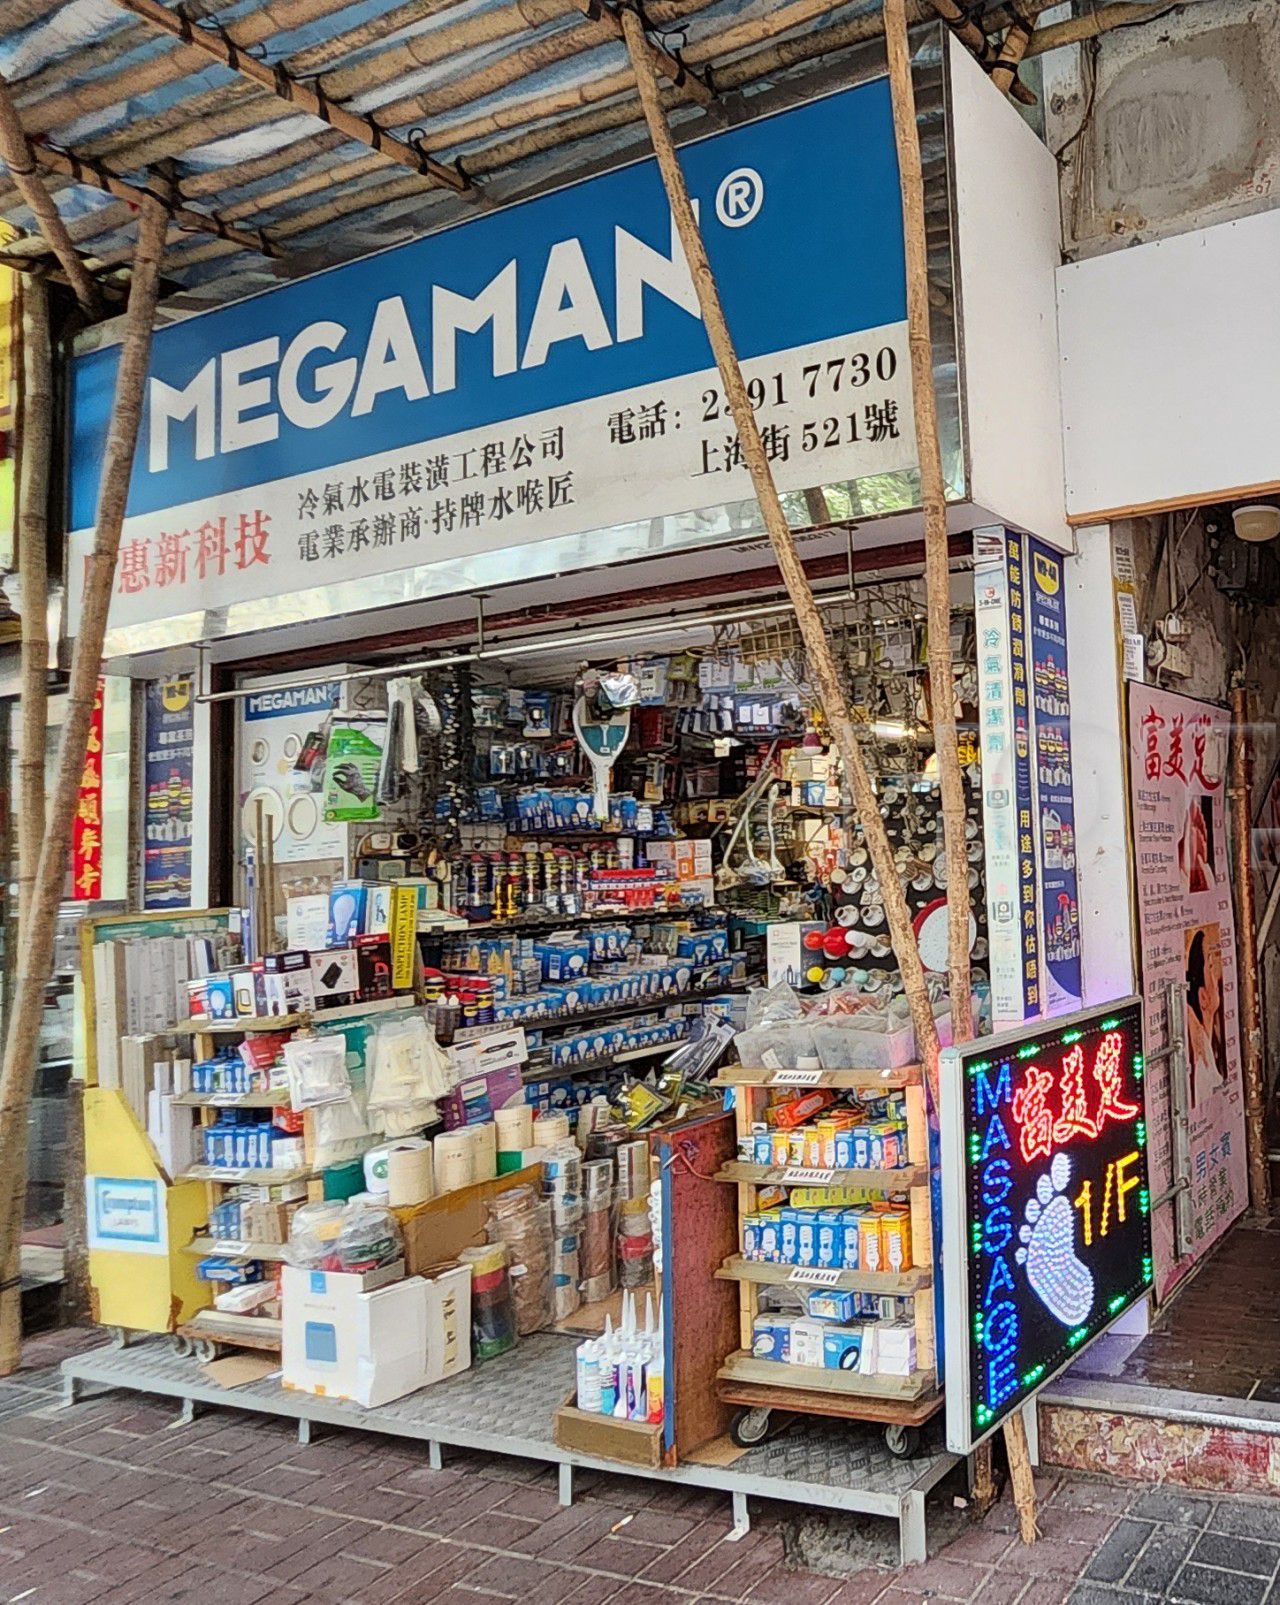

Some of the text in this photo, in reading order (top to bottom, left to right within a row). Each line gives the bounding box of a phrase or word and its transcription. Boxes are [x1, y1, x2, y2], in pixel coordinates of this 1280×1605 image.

[702, 372, 789, 422] 291
[803, 346, 897, 397] 7730
[298, 426, 564, 520] 冷氣水電裝潢工程公司
[84, 510, 272, 599] 惠新科技
[249, 685, 327, 713] MEGAMAN
[974, 1063, 1019, 1408] MASSAGE
[1074, 1151, 1139, 1246] 1/F
